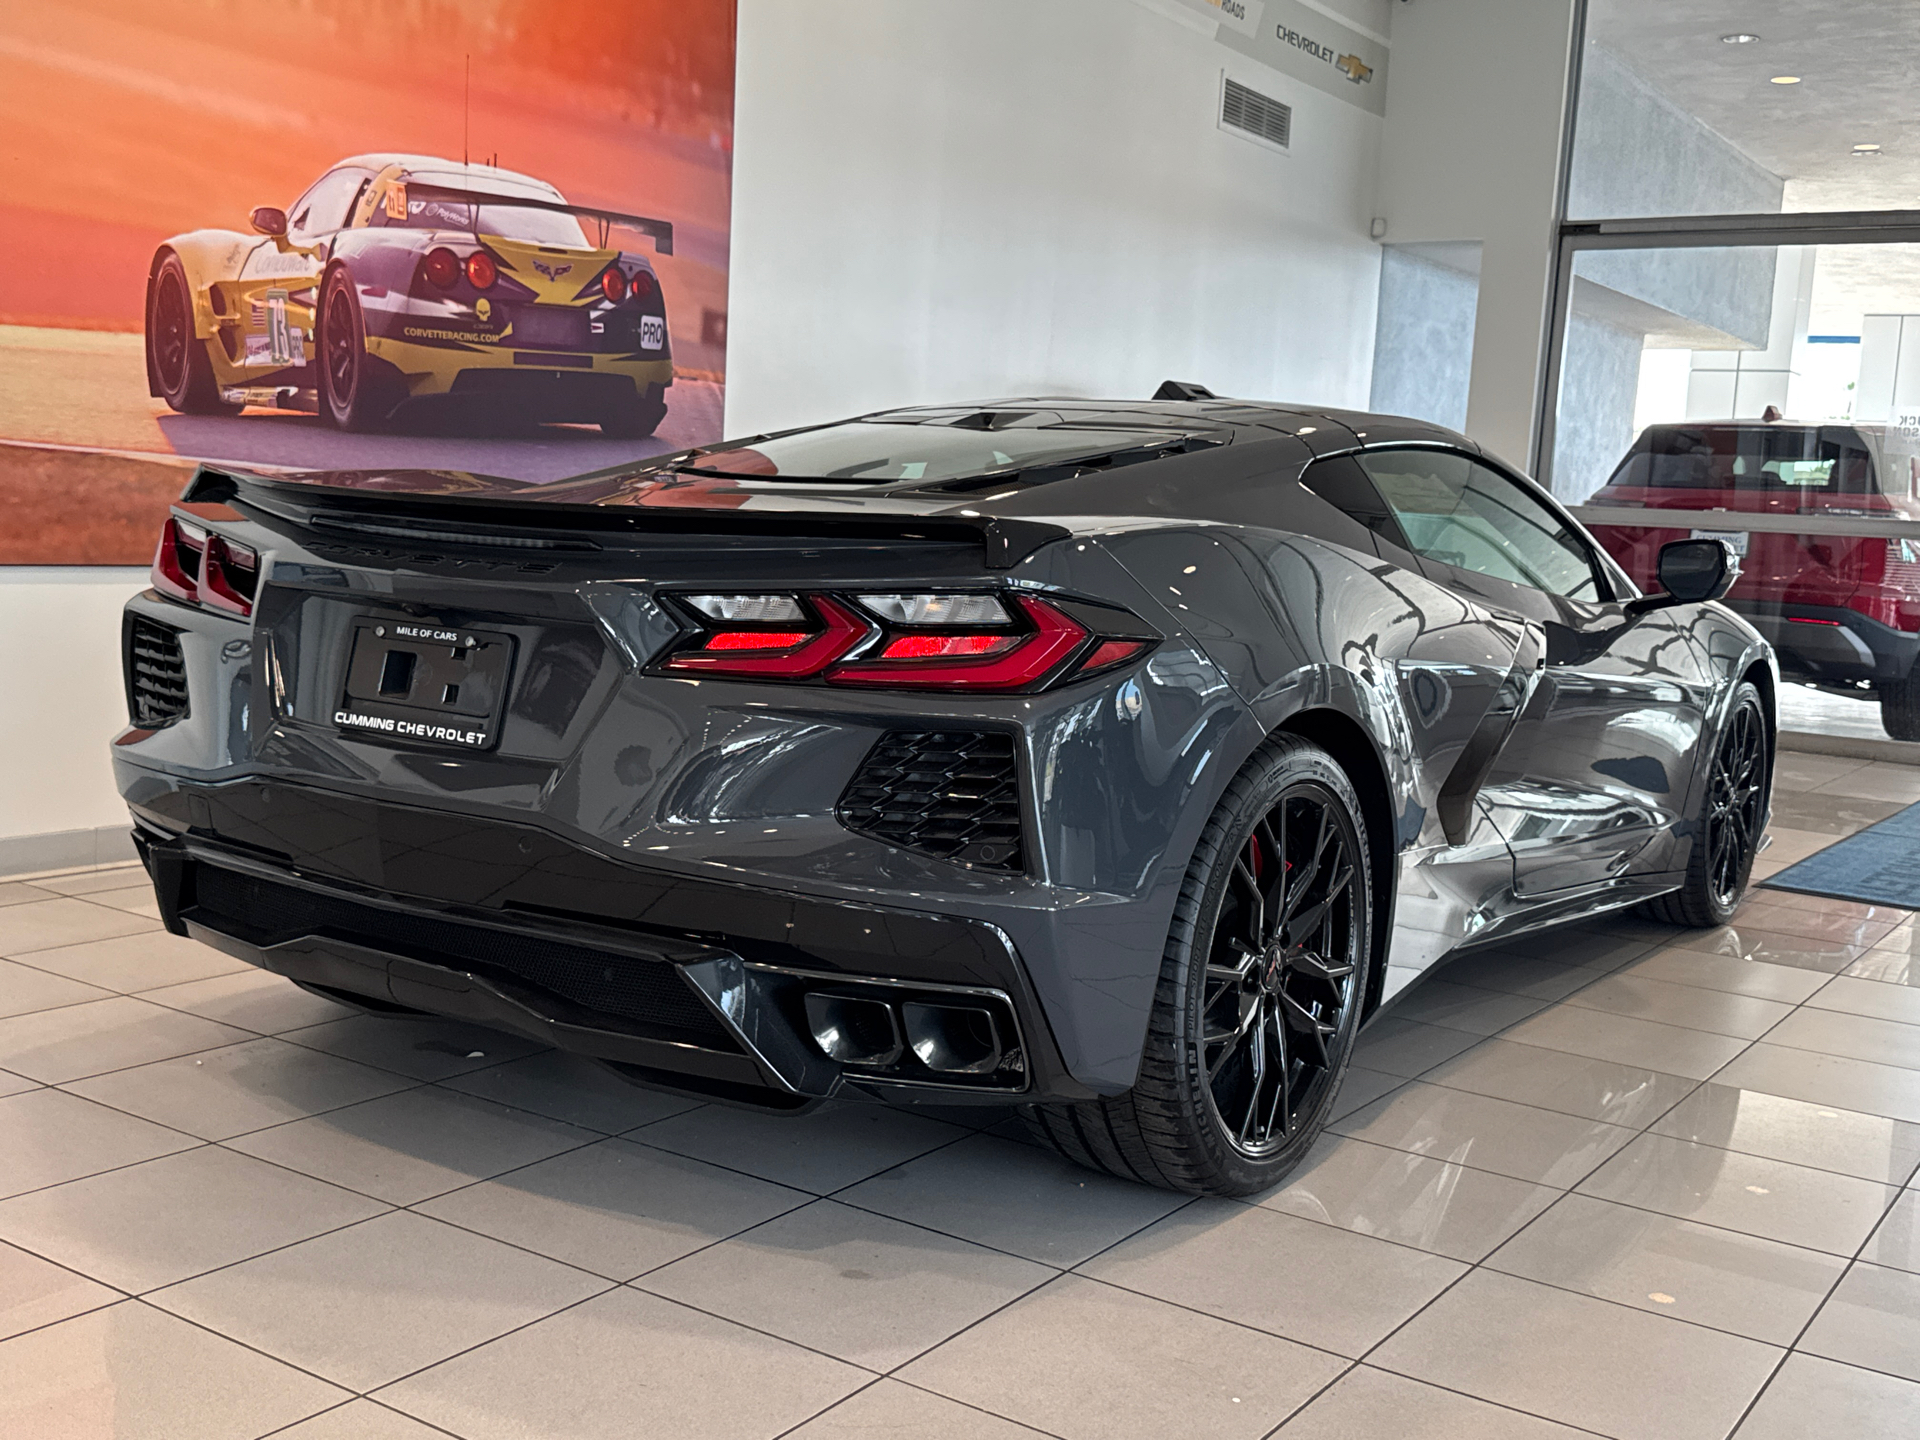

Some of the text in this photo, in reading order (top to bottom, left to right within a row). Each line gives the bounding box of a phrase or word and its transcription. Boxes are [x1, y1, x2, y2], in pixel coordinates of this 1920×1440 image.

[1221, 0, 1246, 20] ROADS
[1276, 24, 1334, 64] CHEVROLET
[404, 326, 500, 343] CORVETTERACING.COM
[642, 322, 663, 344] PRO
[396, 626, 458, 641] MILE OF CARS
[334, 711, 487, 745] CUMMING CHEVROLET
[1188, 1049, 1217, 1148] MICHELIN
